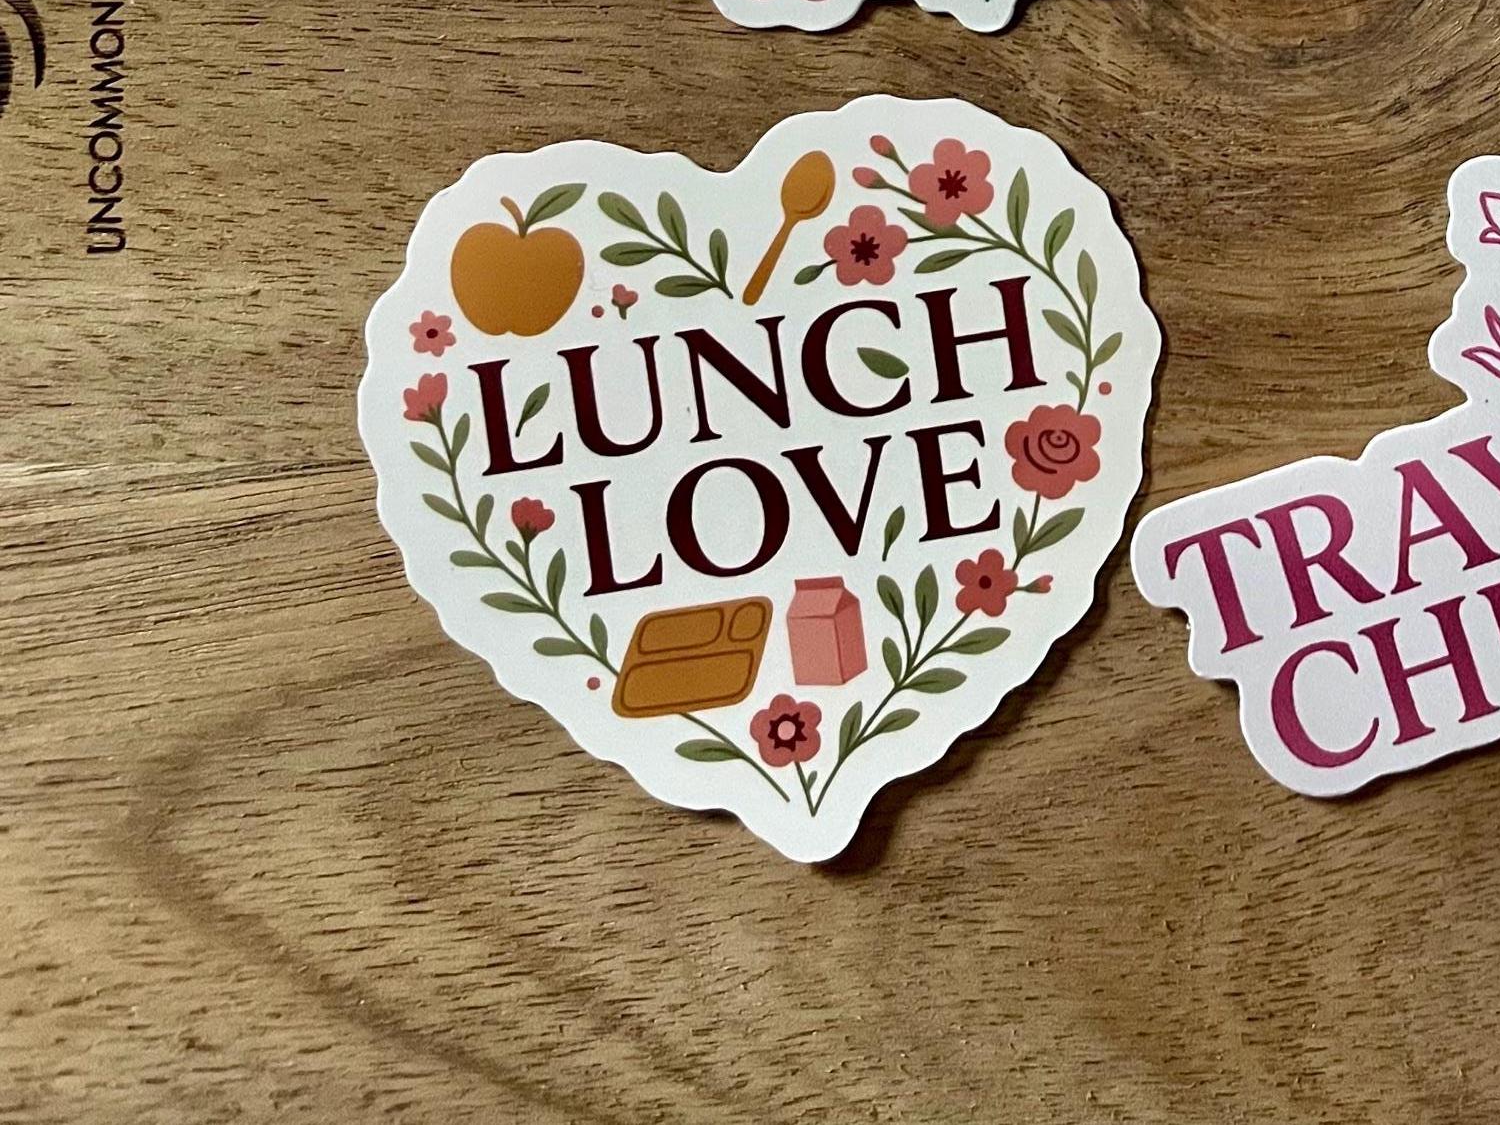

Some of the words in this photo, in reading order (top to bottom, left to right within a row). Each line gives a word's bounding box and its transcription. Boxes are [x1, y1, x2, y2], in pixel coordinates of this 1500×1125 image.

[87, 1, 127, 254] UNCOMMON
[467, 276, 1047, 476] LUNCH
[569, 420, 1001, 597] LOVE
